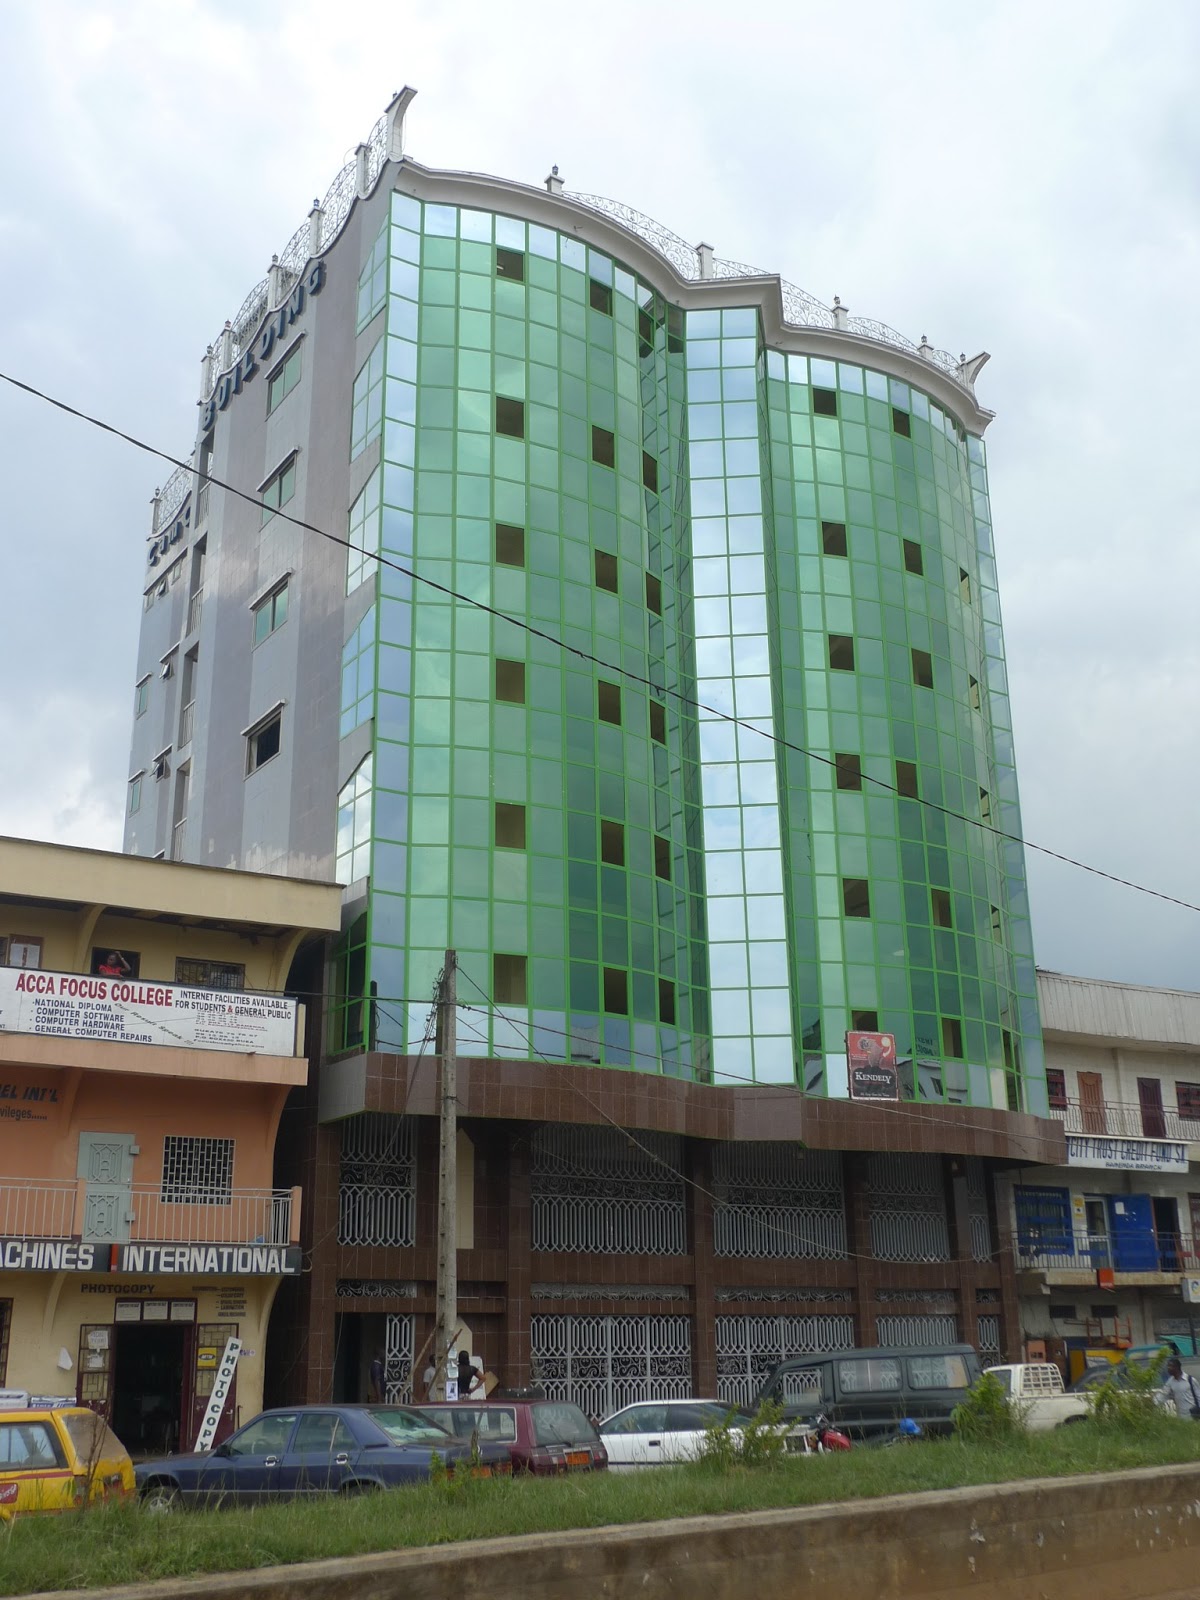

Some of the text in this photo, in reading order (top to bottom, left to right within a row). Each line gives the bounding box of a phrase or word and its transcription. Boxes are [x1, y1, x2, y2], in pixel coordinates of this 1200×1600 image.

[202, 260, 323, 431] BUILDING
[15, 973, 173, 1007] ACCA FOCUS COLLEGE
[180, 990, 288, 1009] INTERNET FACILITIES AVAILABLE
[34, 998, 112, 1012] NATIONAL DIPLOMA
[36, 1007, 125, 1022] COMPUTER SOFTWARE
[175, 1000, 189, 1009] FOR
[191, 1001, 226, 1013] STUDENTS
[227, 1005, 233, 1013] &
[235, 1006, 266, 1017] GENERAL
[267, 1010, 291, 1020] PUBLIC
[35, 1016, 125, 1031] COMPUTER HARDWARE
[35, 1025, 152, 1043] GENERAL COMPUTER REPAIRS
[0, 1084, 17, 1099] EL
[1069, 1137, 1089, 1158] CITY
[1092, 1138, 1118, 1160] TRUST
[1121, 1140, 1148, 1161] CREDIT
[1150, 1142, 1172, 1163] FUND
[0, 1241, 295, 1273] CHINES INTERNATIONAL
[80, 1283, 155, 1294] PHOTOCOPY
[199, 1342, 239, 1451] PHOTOCOPY
